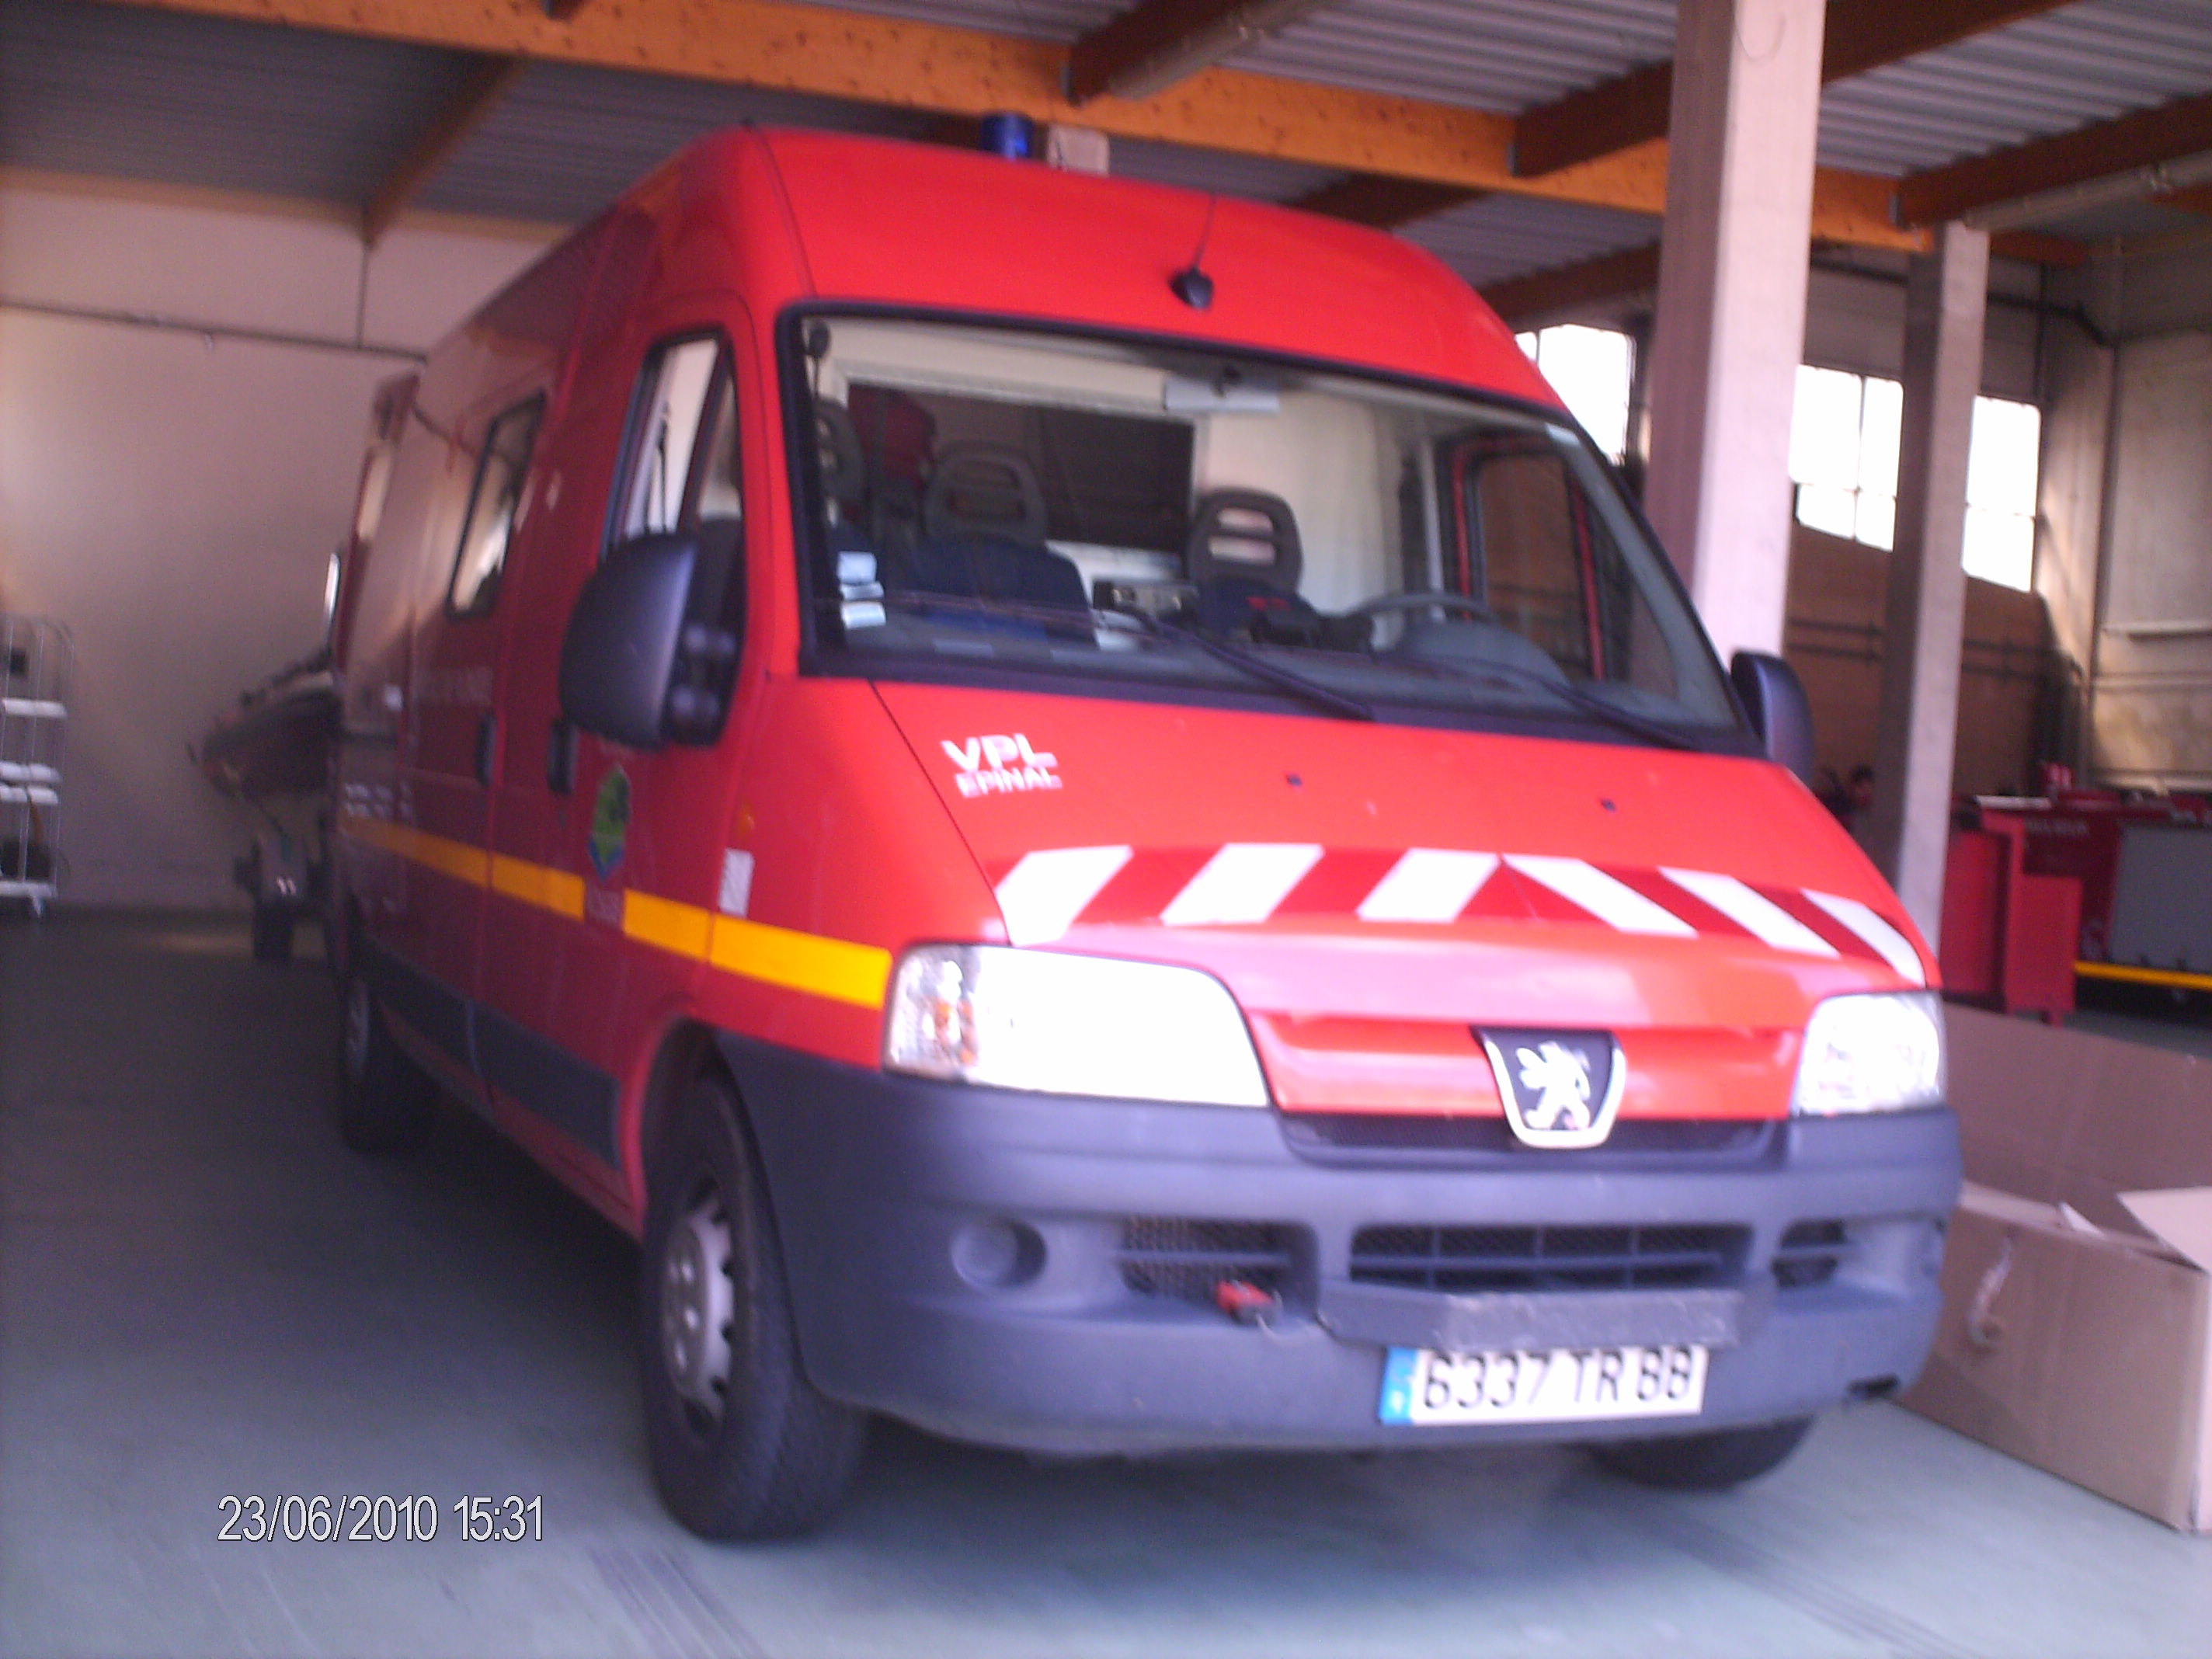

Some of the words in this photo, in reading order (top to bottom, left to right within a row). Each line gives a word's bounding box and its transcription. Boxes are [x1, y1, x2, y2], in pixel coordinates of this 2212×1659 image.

[940, 732, 1059, 772] VPL
[1423, 1349, 1550, 1410] 6337
[1570, 1348, 1626, 1403] TR
